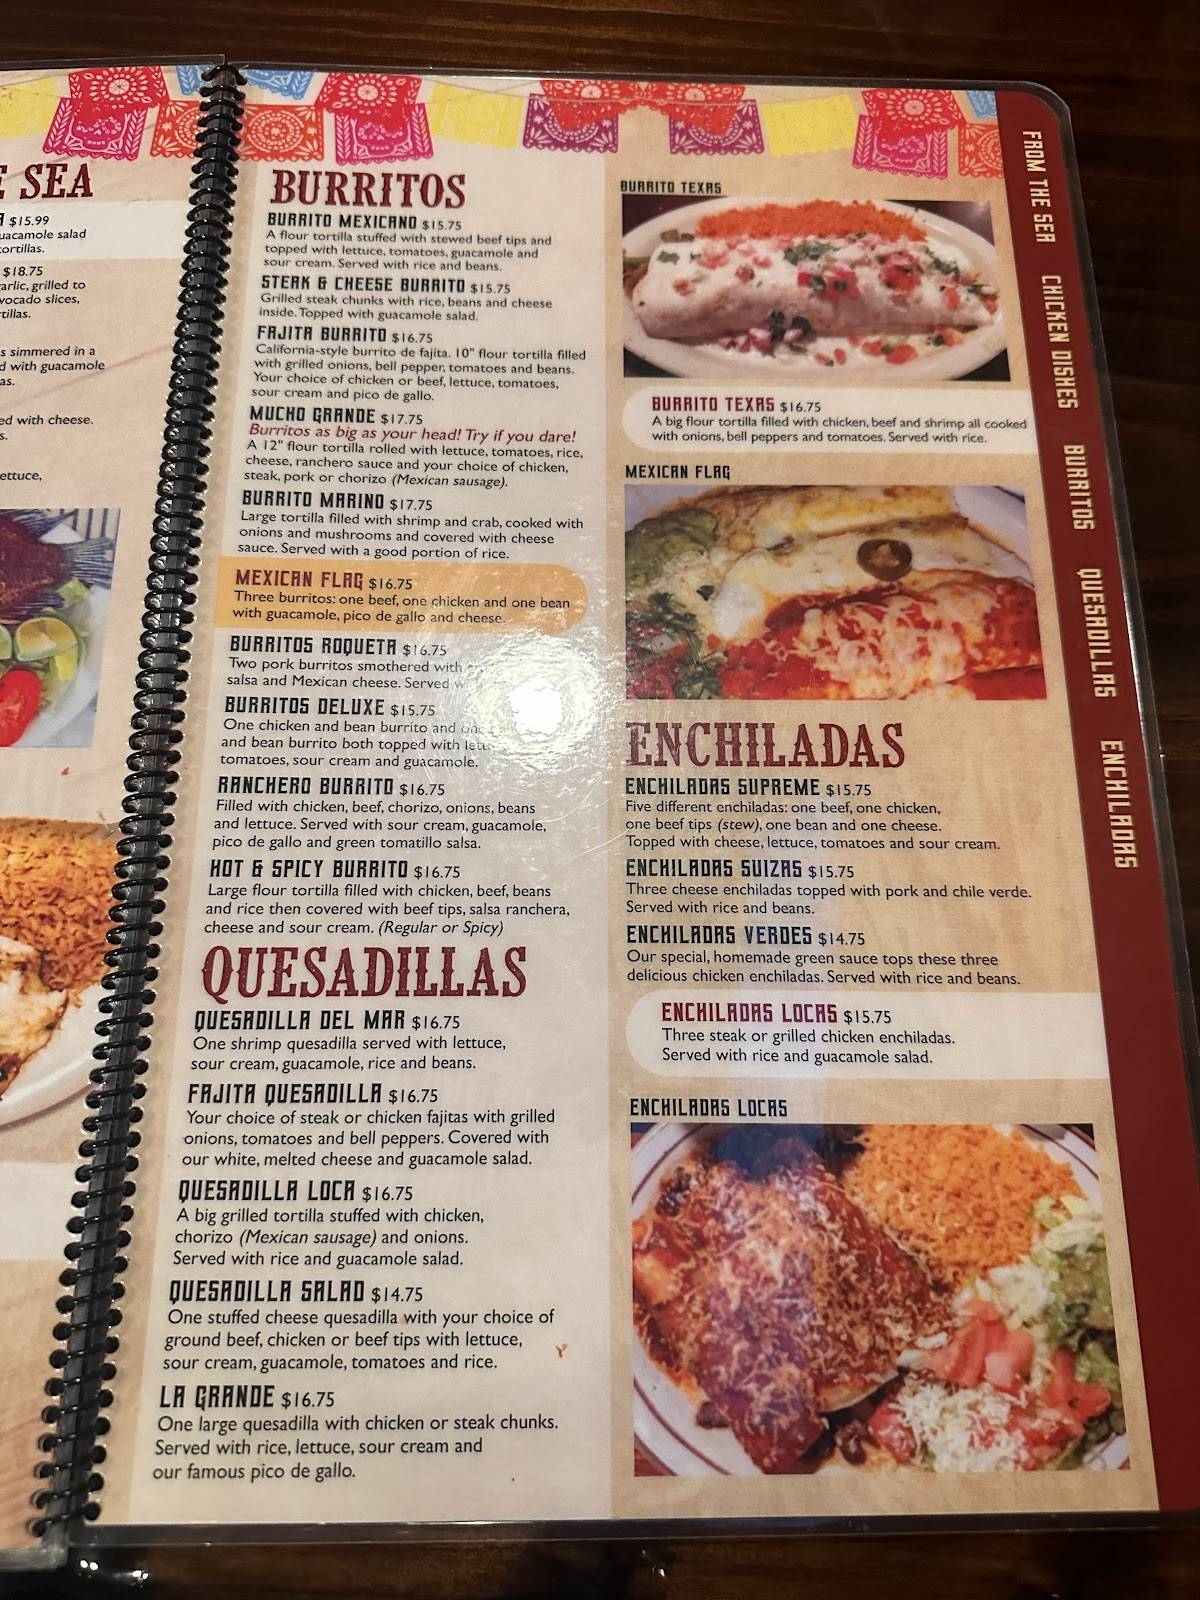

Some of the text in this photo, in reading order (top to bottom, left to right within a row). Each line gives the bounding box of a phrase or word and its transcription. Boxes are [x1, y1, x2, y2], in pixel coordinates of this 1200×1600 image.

[20, 163, 93, 199] SEA
[270, 169, 466, 209] BURRITOS
[620, 180, 721, 194] BURRITO TEXAS
[1022, 131, 1056, 243] FROM THE SEA
[9, 216, 50, 227] $15.99
[267, 212, 462, 231] BURRITO MEXICANO $15.75
[0, 229, 87, 240] uacamole salad
[265, 244, 539, 260] topped with lettuce, tomatoes, guacamole and
[3, 266, 43, 278] $18.75
[32, 280, 69, 292] grilled
[73, 281, 86, 290] to
[262, 275, 511, 295] STEAK & CHEESE BURRITO $15.75
[0, 294, 80, 305] vocado slices,
[257, 325, 433, 344] FAJITA BURRITO $16.75
[1041, 275, 1079, 409] CHICKEN DISHES
[10, 346, 70, 357] simmered
[75, 346, 85, 356] in
[11, 361, 37, 371] with
[40, 360, 105, 374] guacamole
[652, 396, 821, 414] BURRITO TEXAS $16.75
[17, 415, 44, 425] with
[48, 414, 94, 425] cheese.
[249, 406, 423, 426] MUCHO GRANDE $17.75
[652, 416, 1027, 431] A big flour tortilla filled with chicken, beef and shrimp all cooked
[249, 423, 577, 446] Burritos as big as your head! Try if you dare!
[0, 473, 42, 482] ettuce,
[625, 465, 731, 481] MEXICAN FLAG
[1063, 444, 1095, 530] BURRITOS
[242, 490, 433, 511] BURRITO MARINO $17.75
[235, 569, 413, 591] MEXICAN FLAG $16.75
[1076, 568, 1117, 698] QUESADILLAS
[229, 636, 447, 657] BURRITOS ROQUETA $16.75
[225, 696, 435, 717] BURRITOS DELUXE $15.75
[626, 722, 905, 768] ENCHILADAS
[218, 776, 445, 797] RANCHERO BURRITO $16.75
[625, 778, 871, 798] ENCHILADAS SUPREME $15.75
[1100, 740, 1139, 868] ENCHILADAS
[210, 859, 460, 880] HOT & SPICY BURRITO $16.75
[626, 859, 854, 880] ENCHILADAS SUIZAS $15.75
[204, 920, 503, 938] cheese and sour cream. (Regular or Spicy)
[626, 925, 865, 947] ENCHILADAS VERDES $14.75
[201, 946, 527, 1004] QUESADILLAS
[194, 1010, 460, 1032] QUESADILLA DEL MAR $16.75
[661, 1003, 891, 1025] ENCHILADAS LOCAS $15.75
[188, 1083, 438, 1107] FAJITA QUESADILLA $16.75
[630, 1098, 787, 1117] ENCHILADAS LOCAS
[178, 1180, 413, 1204] QUESADILLA LOCA $16.75
[169, 1280, 423, 1305] QUESADILLA SALAD $14.75
[160, 1384, 334, 1412] LA GRANDE $16.75
[158, 1413, 559, 1436] One large quesadilla with chicken or steak chunks.
[153, 1461, 356, 1484] our famous pico de gallo.
